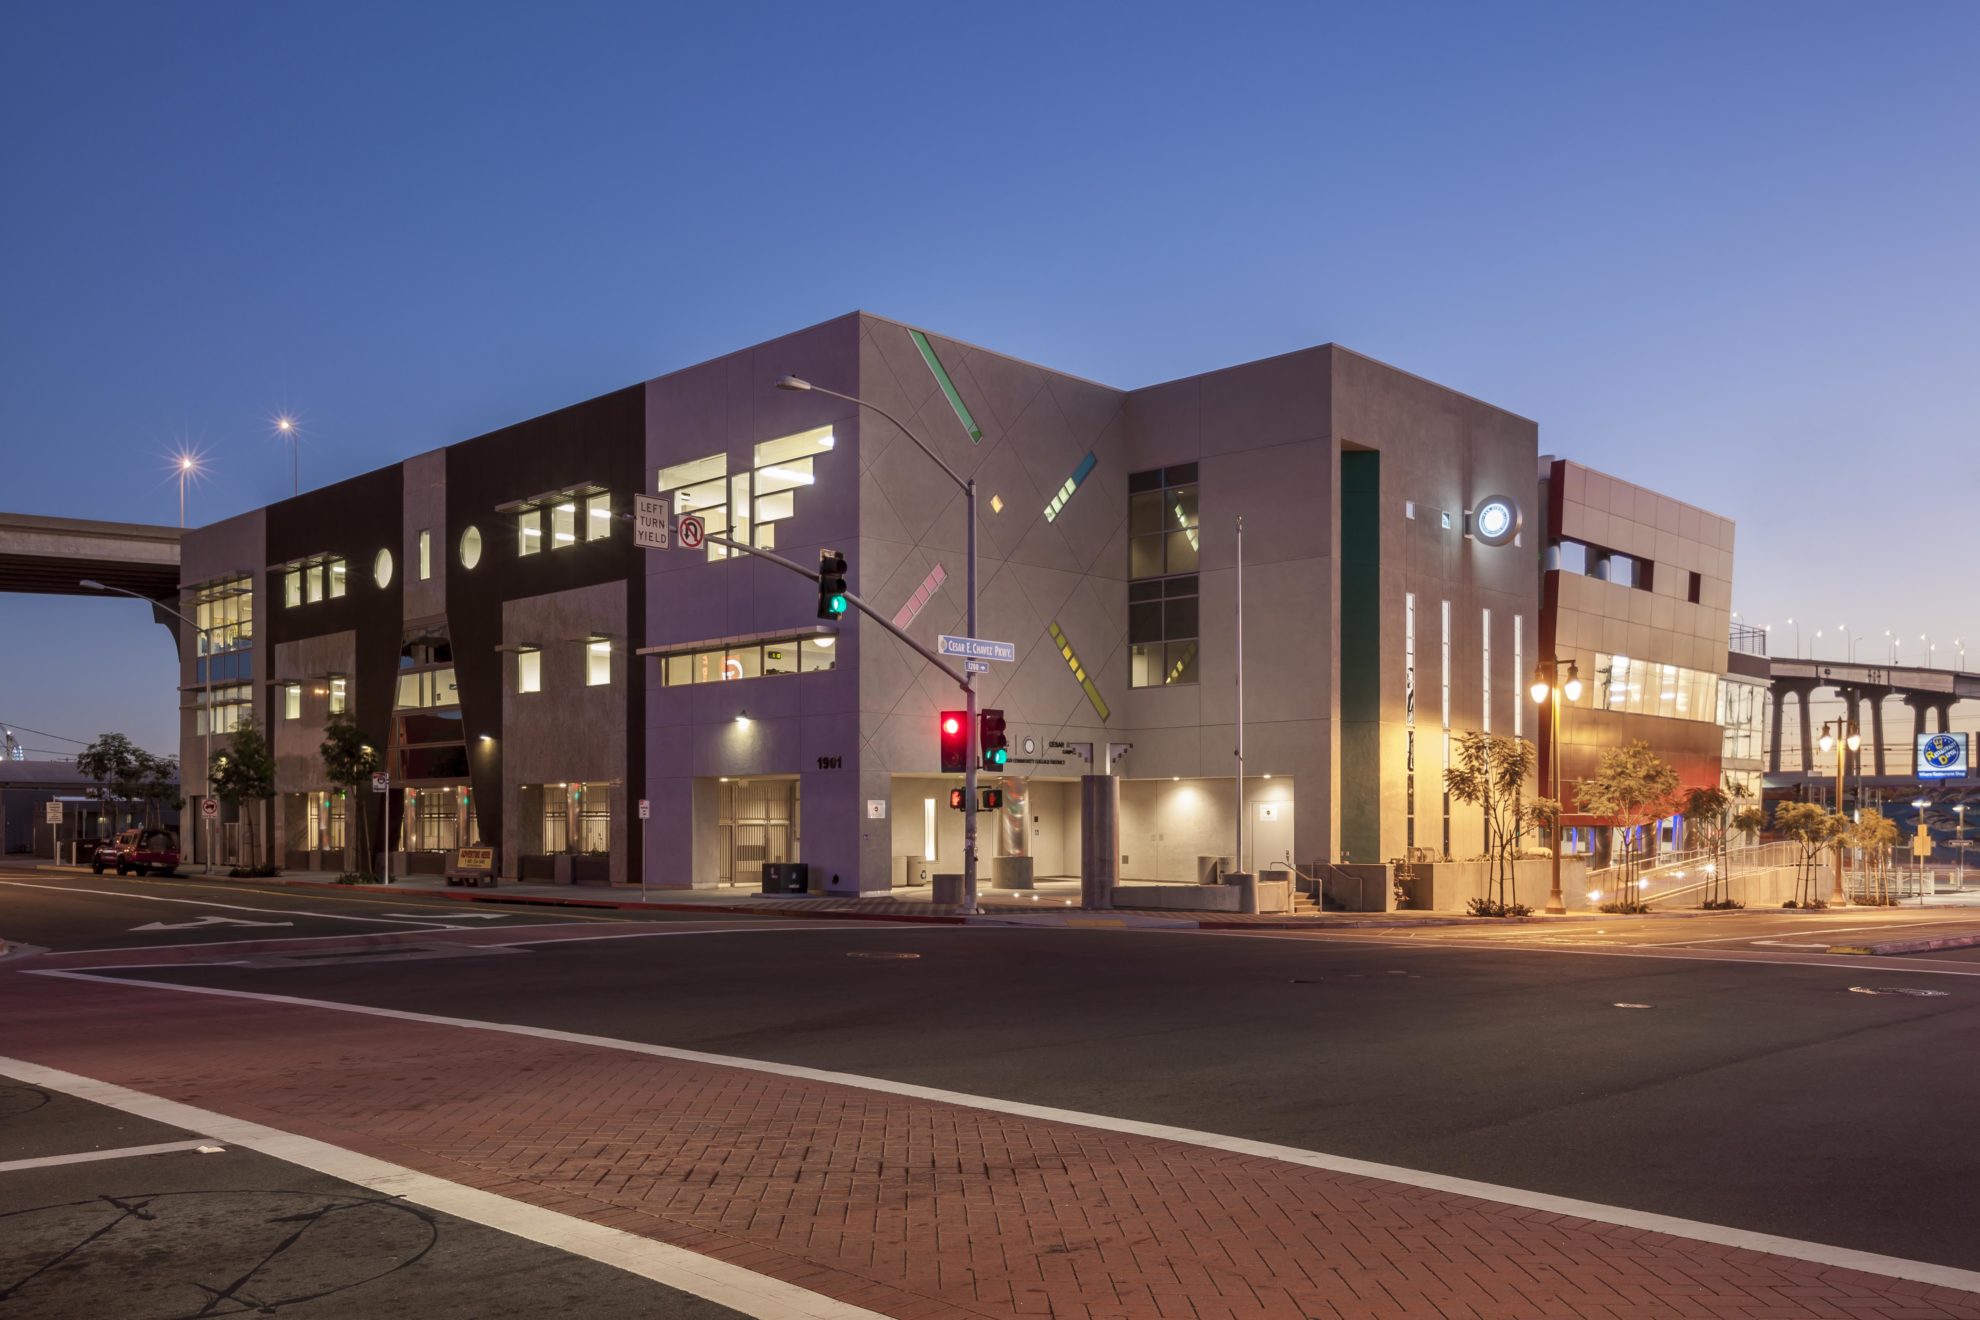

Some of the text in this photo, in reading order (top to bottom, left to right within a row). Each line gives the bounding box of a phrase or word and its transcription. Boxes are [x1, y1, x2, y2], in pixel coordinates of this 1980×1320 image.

[641, 502, 663, 515] LEFT
[640, 516, 665, 529] TURN
[638, 530, 667, 543] YIELD
[817, 755, 842, 770] 1901
